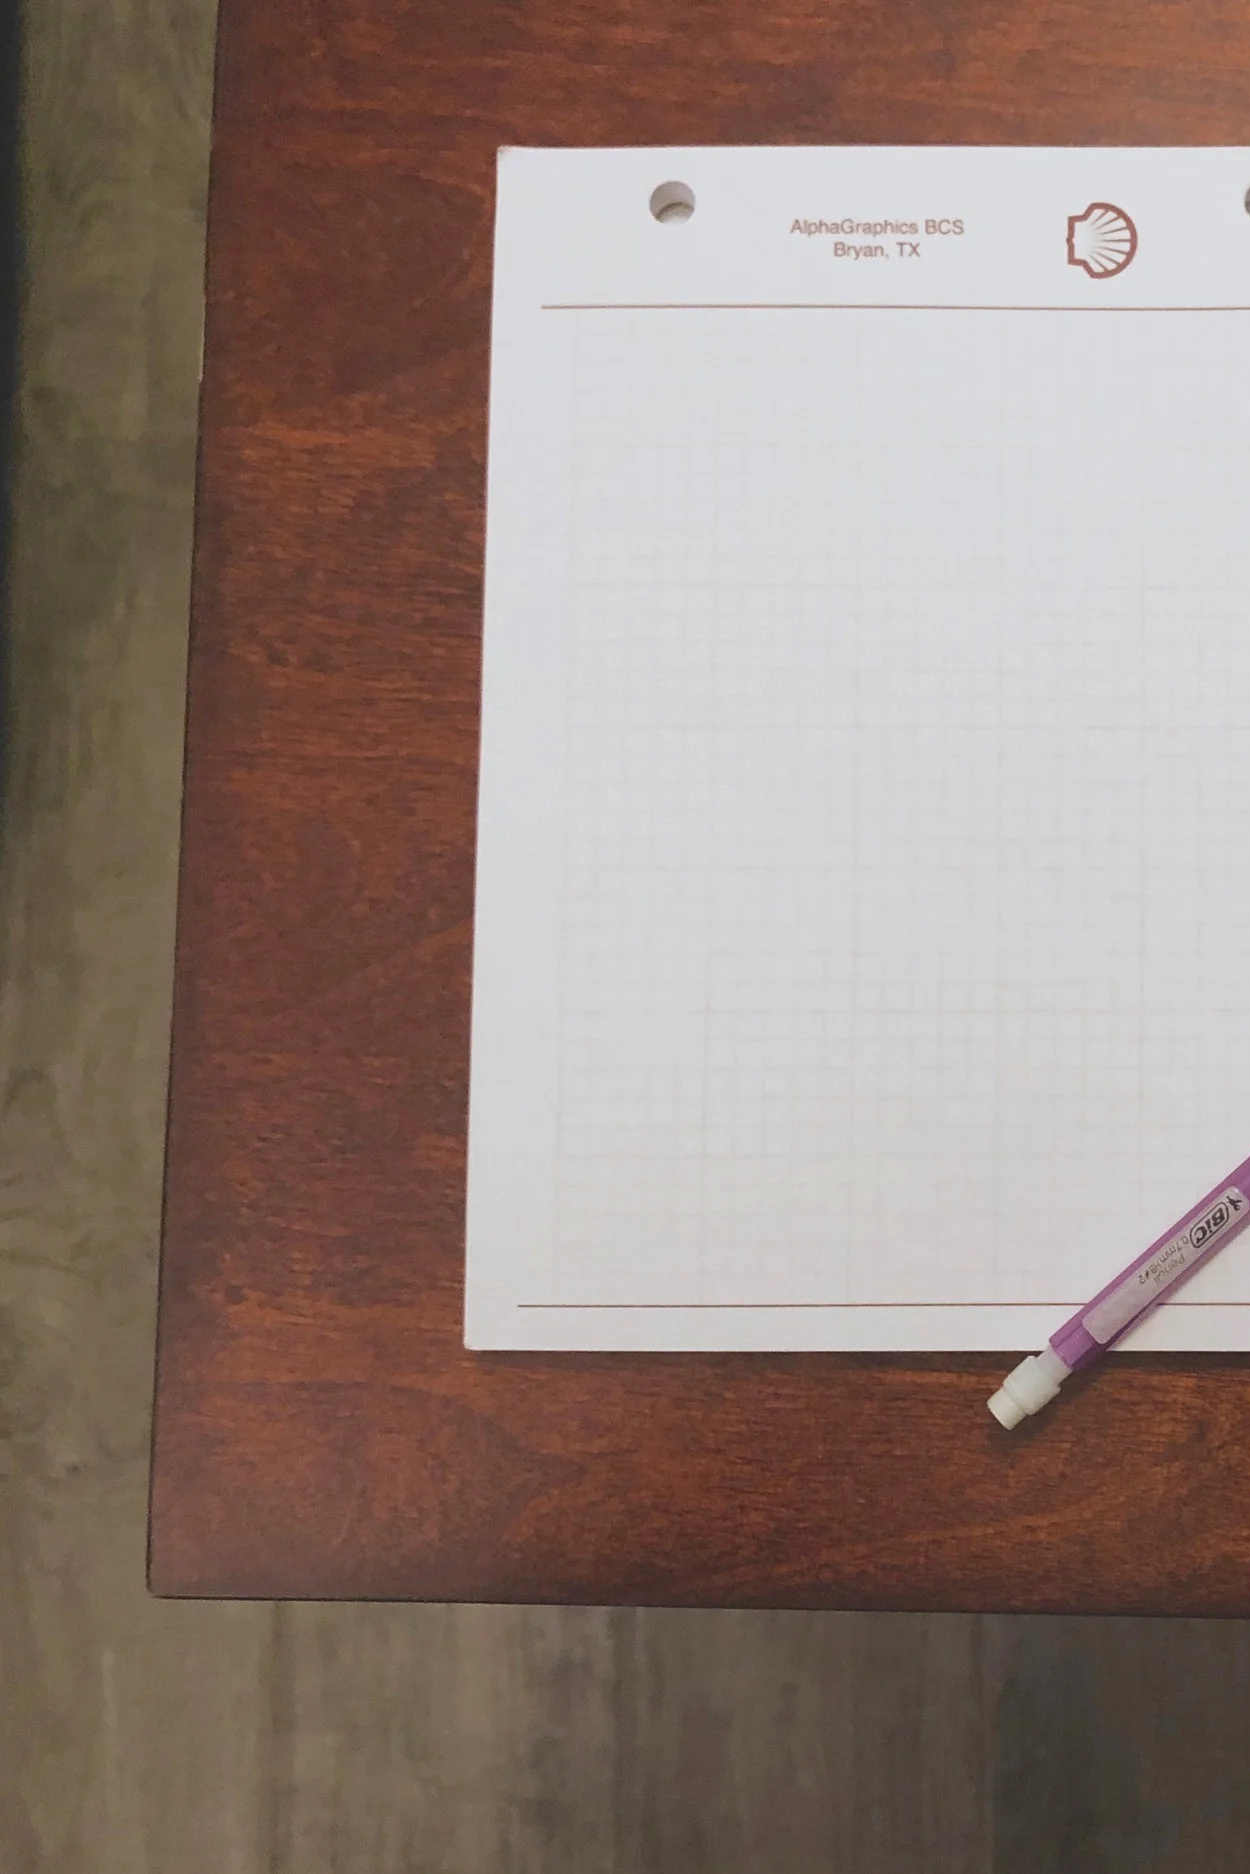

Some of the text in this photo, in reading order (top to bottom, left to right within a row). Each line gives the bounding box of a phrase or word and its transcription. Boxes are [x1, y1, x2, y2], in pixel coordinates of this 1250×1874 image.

[790, 219, 965, 238] AlphaGraphics BCS
[833, 242, 921, 260] Bryan, TX
